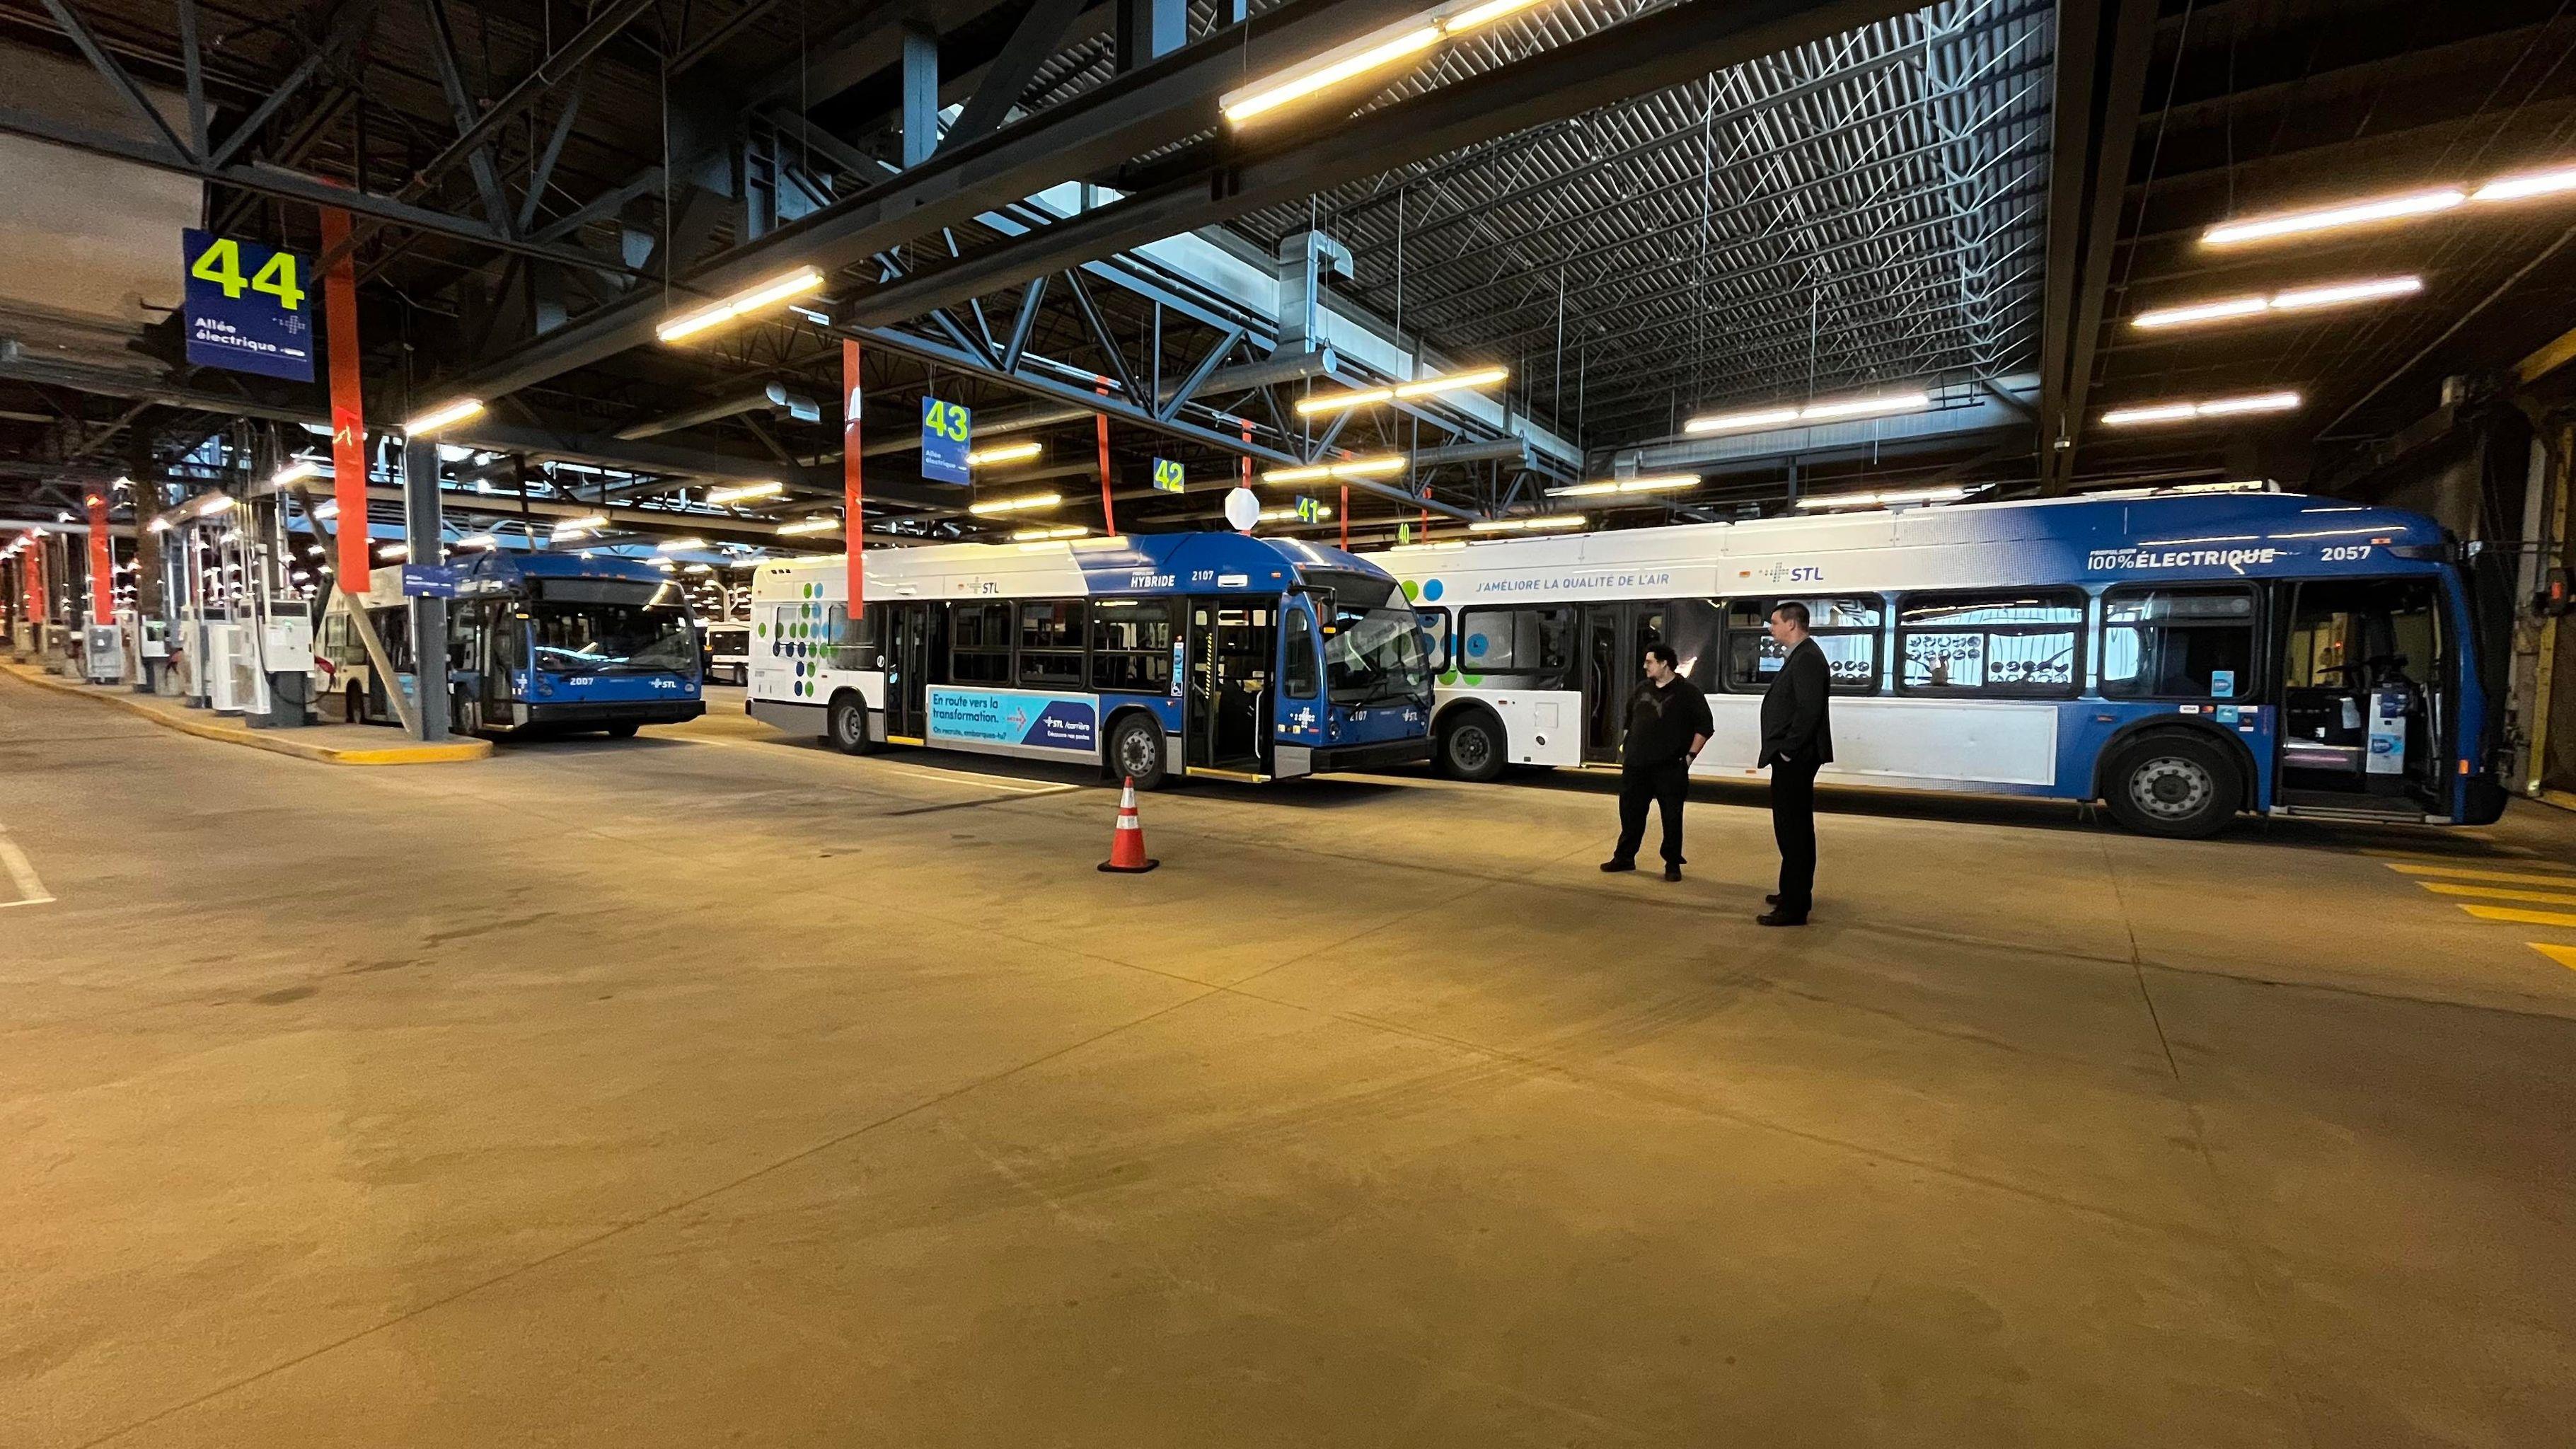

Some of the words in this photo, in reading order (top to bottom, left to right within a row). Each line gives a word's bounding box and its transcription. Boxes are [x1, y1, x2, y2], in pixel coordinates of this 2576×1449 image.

[192, 238, 305, 310] 44
[195, 318, 236, 333] Allée
[196, 329, 277, 352] électrique
[926, 400, 968, 441] 43
[1155, 460, 1184, 493] 42
[1298, 498, 1318, 524] 41
[1399, 523, 1409, 544] 40
[2321, 545, 2371, 561] 2057
[1131, 575, 1175, 588] HYBRIDE
[1191, 570, 1214, 581] 2107
[1791, 567, 1824, 582] STL
[982, 582, 999, 594] STL
[1476, 579, 1541, 592] J'AMÉLIORE
[1544, 579, 1559, 589] LA
[1563, 575, 1615, 589] QUALITÉ
[1618, 576, 1634, 586] DE
[1639, 574, 1669, 585] L'AIR
[933, 694, 943, 705] En
[945, 696, 967, 707] route
[969, 698, 988, 708] vers
[990, 696, 998, 709] la
[933, 708, 999, 723] transformation.
[1053, 720, 1063, 728] STL
